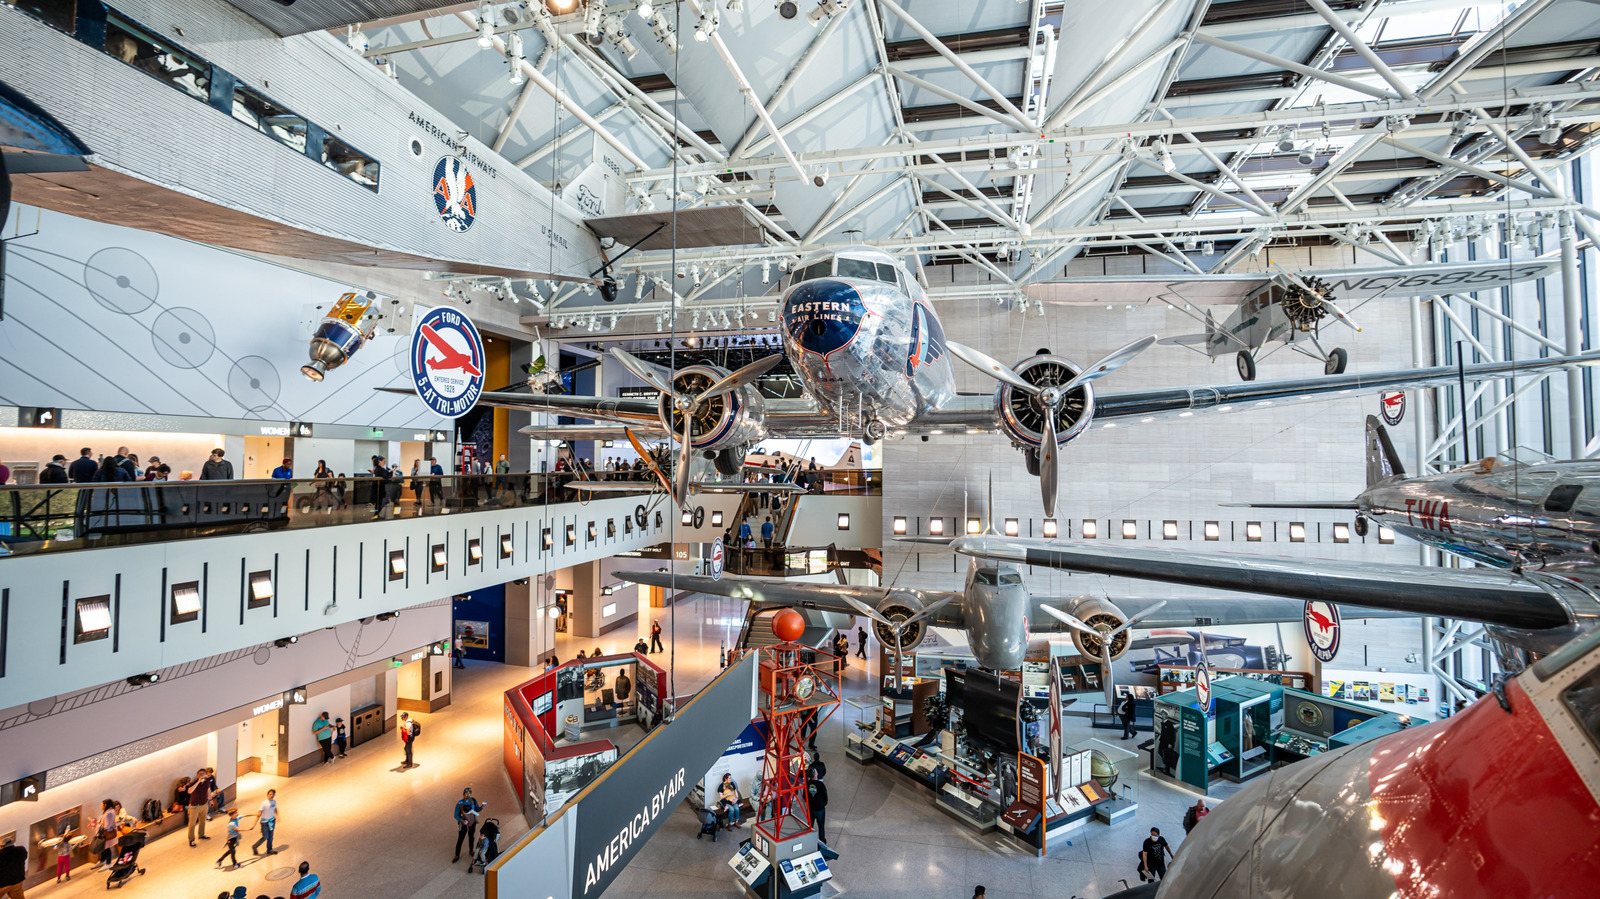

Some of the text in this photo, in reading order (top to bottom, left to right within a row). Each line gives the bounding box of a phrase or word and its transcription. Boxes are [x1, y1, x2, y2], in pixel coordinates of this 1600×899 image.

[408, 110, 497, 179] AMERICAN AIRWAYS
[433, 177, 451, 201] A
[460, 192, 475, 217] A
[576, 184, 602, 215] Ford
[553, 232, 568, 249] MAIL
[1331, 264, 1549, 291] NC6853
[791, 301, 850, 314] EASTERN
[441, 311, 461, 327] FORD
[796, 312, 842, 323] AIR LINES
[434, 375, 465, 386] ENTERED SERVICE
[444, 384, 455, 394] 1928
[417, 376, 480, 414] 5-AT TRI-MOTOR
[260, 426, 291, 435] WOMEN
[413, 433, 427, 441] MEN
[1405, 498, 1454, 534] TWA
[675, 551, 688, 559] 105
[411, 651, 424, 661] MEN
[253, 699, 284, 716] WOMEN
[583, 767, 685, 895] AMERICA BY AIR
